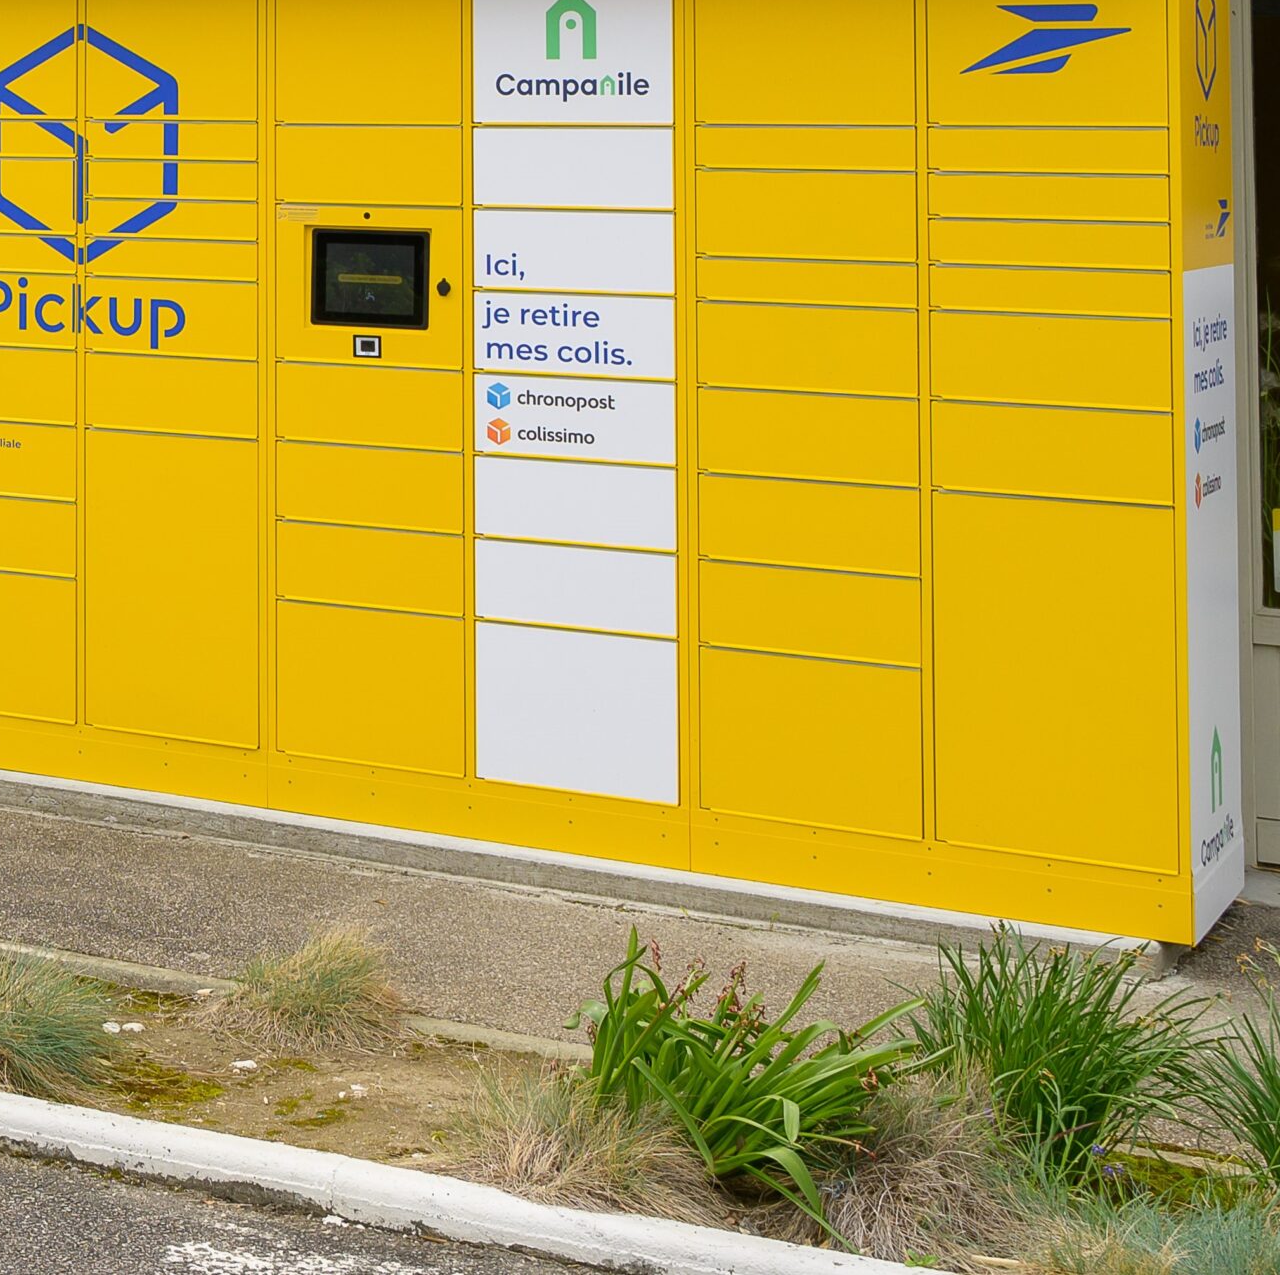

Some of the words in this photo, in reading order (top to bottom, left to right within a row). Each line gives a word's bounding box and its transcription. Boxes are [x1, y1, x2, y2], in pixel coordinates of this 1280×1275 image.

[495, 71, 650, 103] Campanile
[1194, 113, 1220, 154] Pickup
[486, 253, 525, 281] Ici,
[482, 300, 510, 329] je
[520, 303, 600, 328] retire
[486, 341, 548, 362] mes
[557, 340, 632, 366] colis.
[517, 390, 616, 412] chronopost
[517, 426, 595, 445] colissimo
